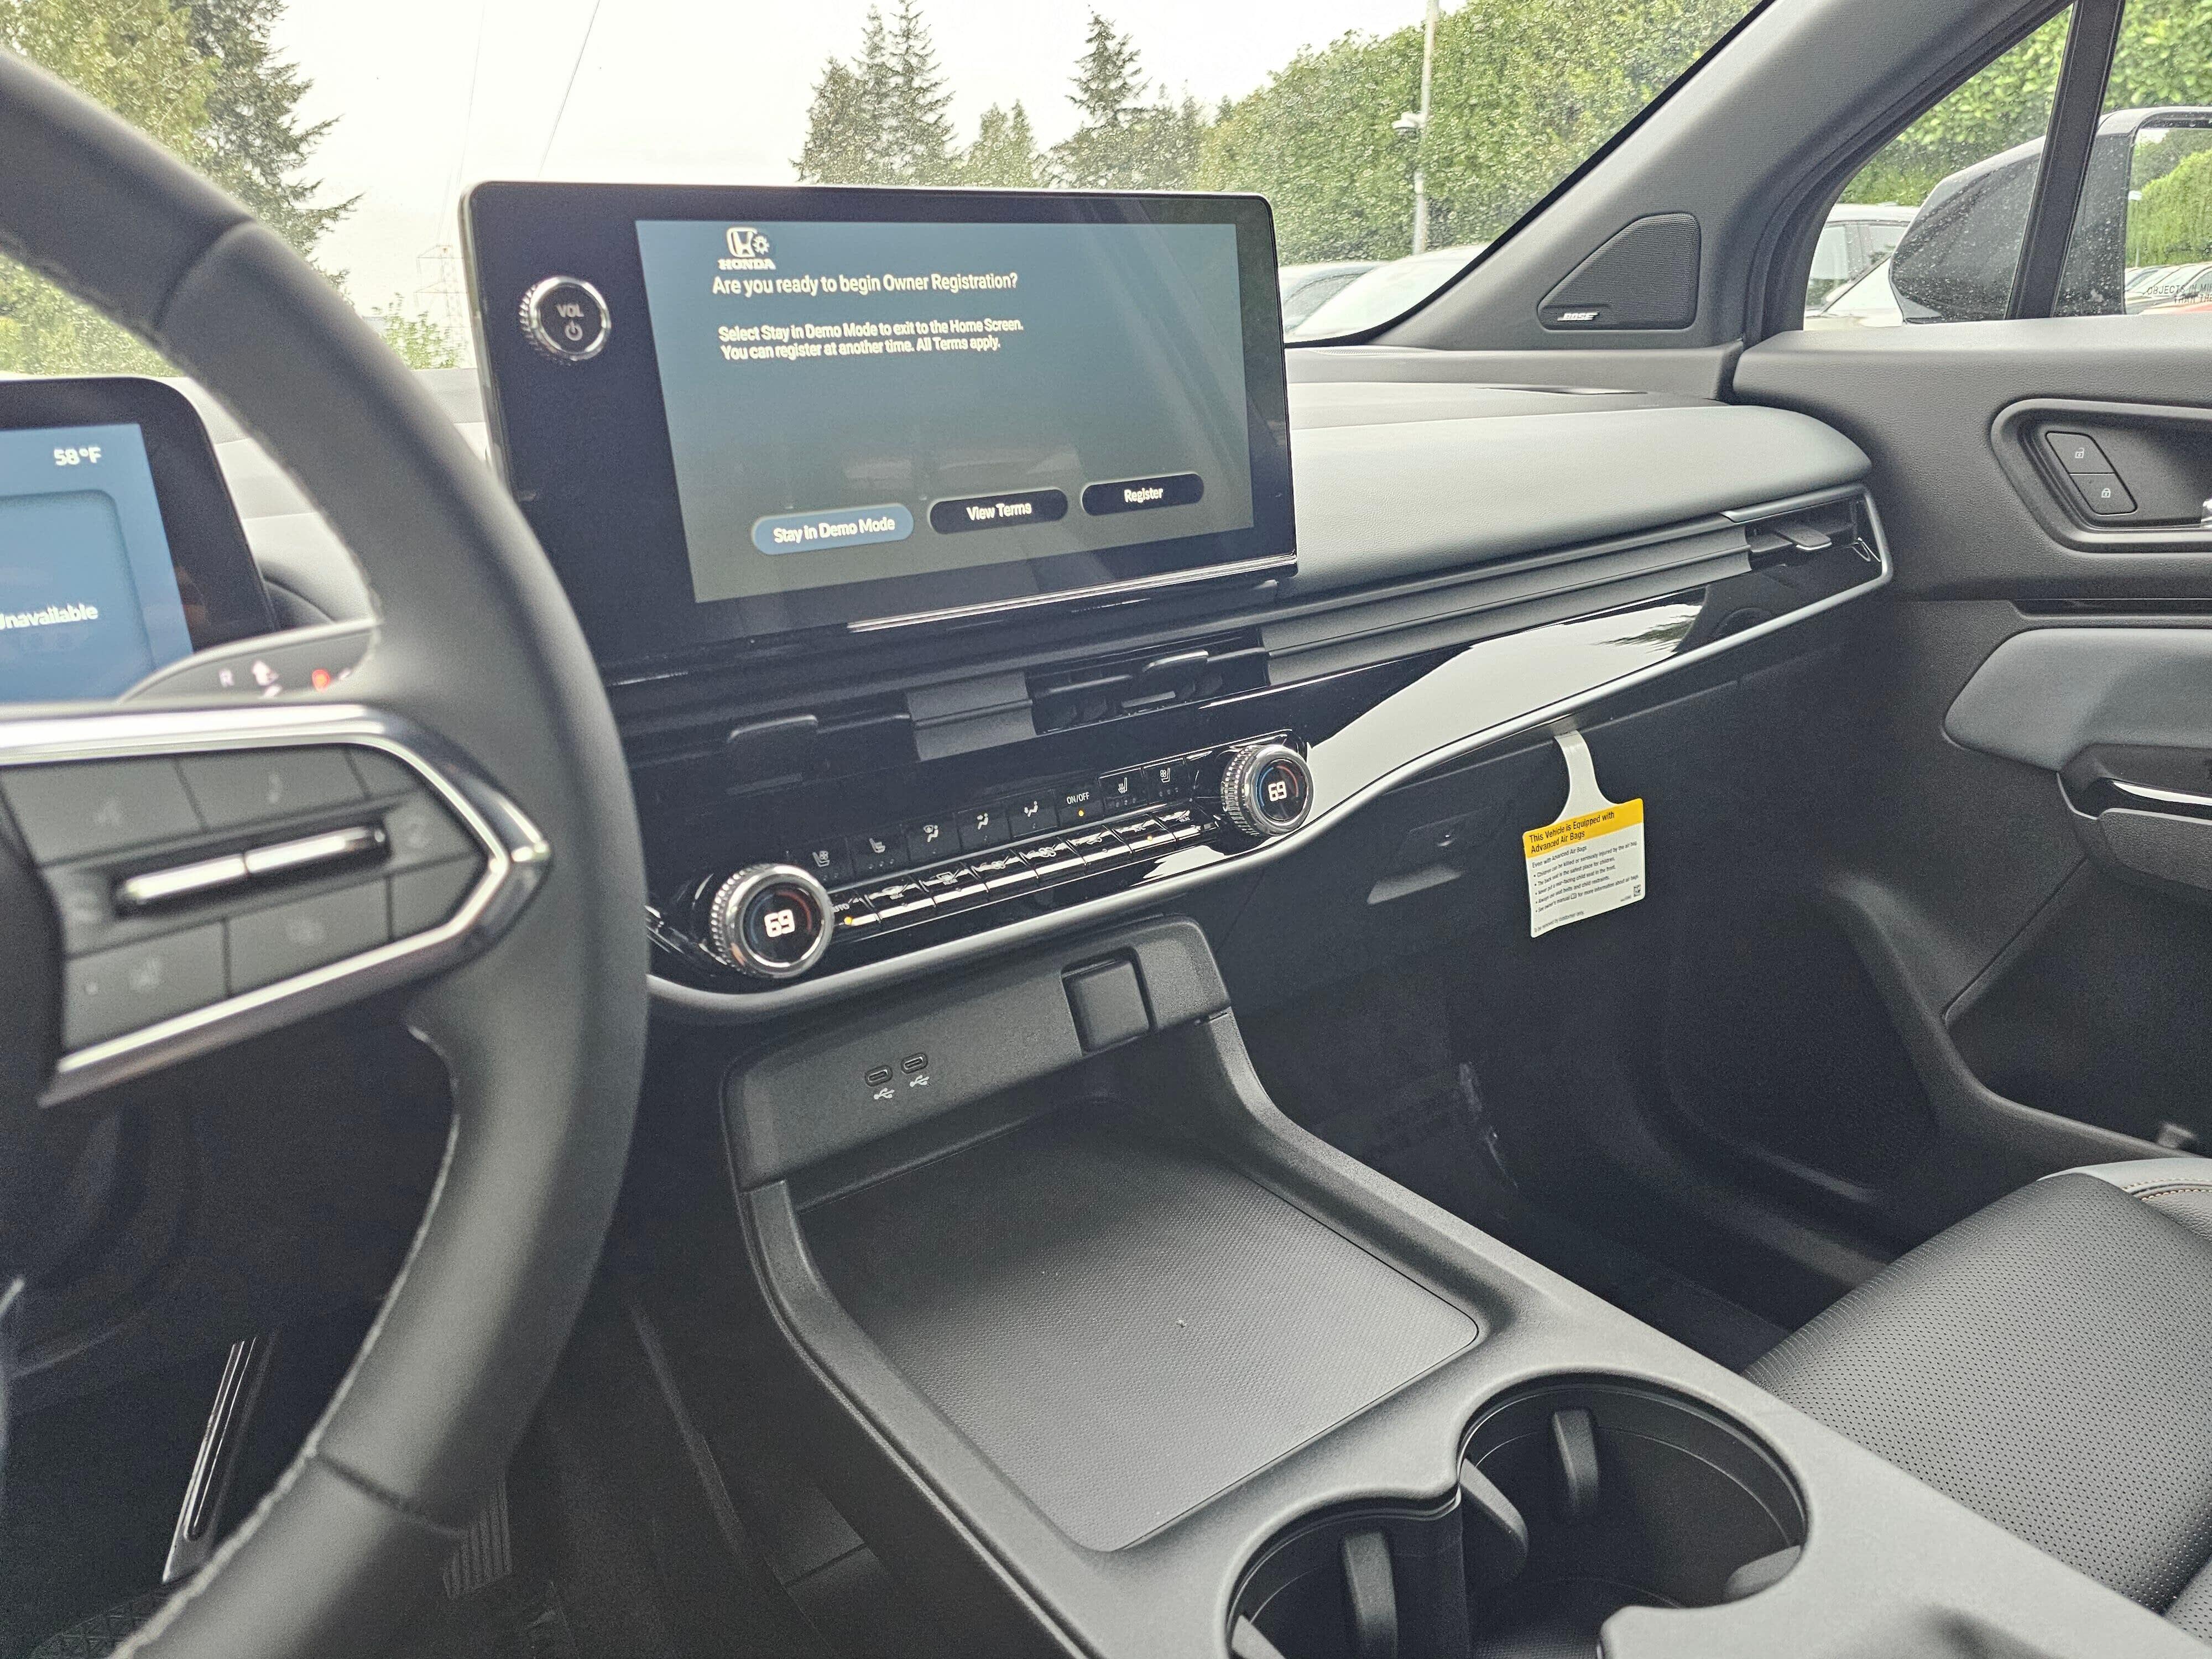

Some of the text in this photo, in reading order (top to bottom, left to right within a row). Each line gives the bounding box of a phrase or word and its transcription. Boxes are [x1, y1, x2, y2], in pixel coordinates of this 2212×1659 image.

[718, 258, 776, 270] HONDA
[712, 272, 1018, 298] Are you ready to begin Owner Registration?
[2147, 285, 2185, 295] OBJECTS
[556, 303, 585, 317] VOL
[1557, 311, 1599, 321] BOSE
[718, 318, 1024, 343] Select Stay in Demo Mode to exit to the Home Screen.
[721, 334, 1001, 360] You can register at another time. All Terms apply.
[1124, 487, 1164, 504] Register
[966, 502, 1032, 521] View Terms
[773, 517, 895, 544] Stay in Demo Mode
[1066, 791, 1089, 805] ON/OFF
[1268, 780, 1287, 802] 69
[1529, 833, 1543, 843] This
[1545, 826, 1565, 839] Vehicle
[1573, 815, 1600, 830] Equipped
[1602, 811, 1614, 821] with
[1531, 837, 1559, 854] Advanced
[1570, 831, 1585, 840] Bags
[764, 909, 795, 938] 69
